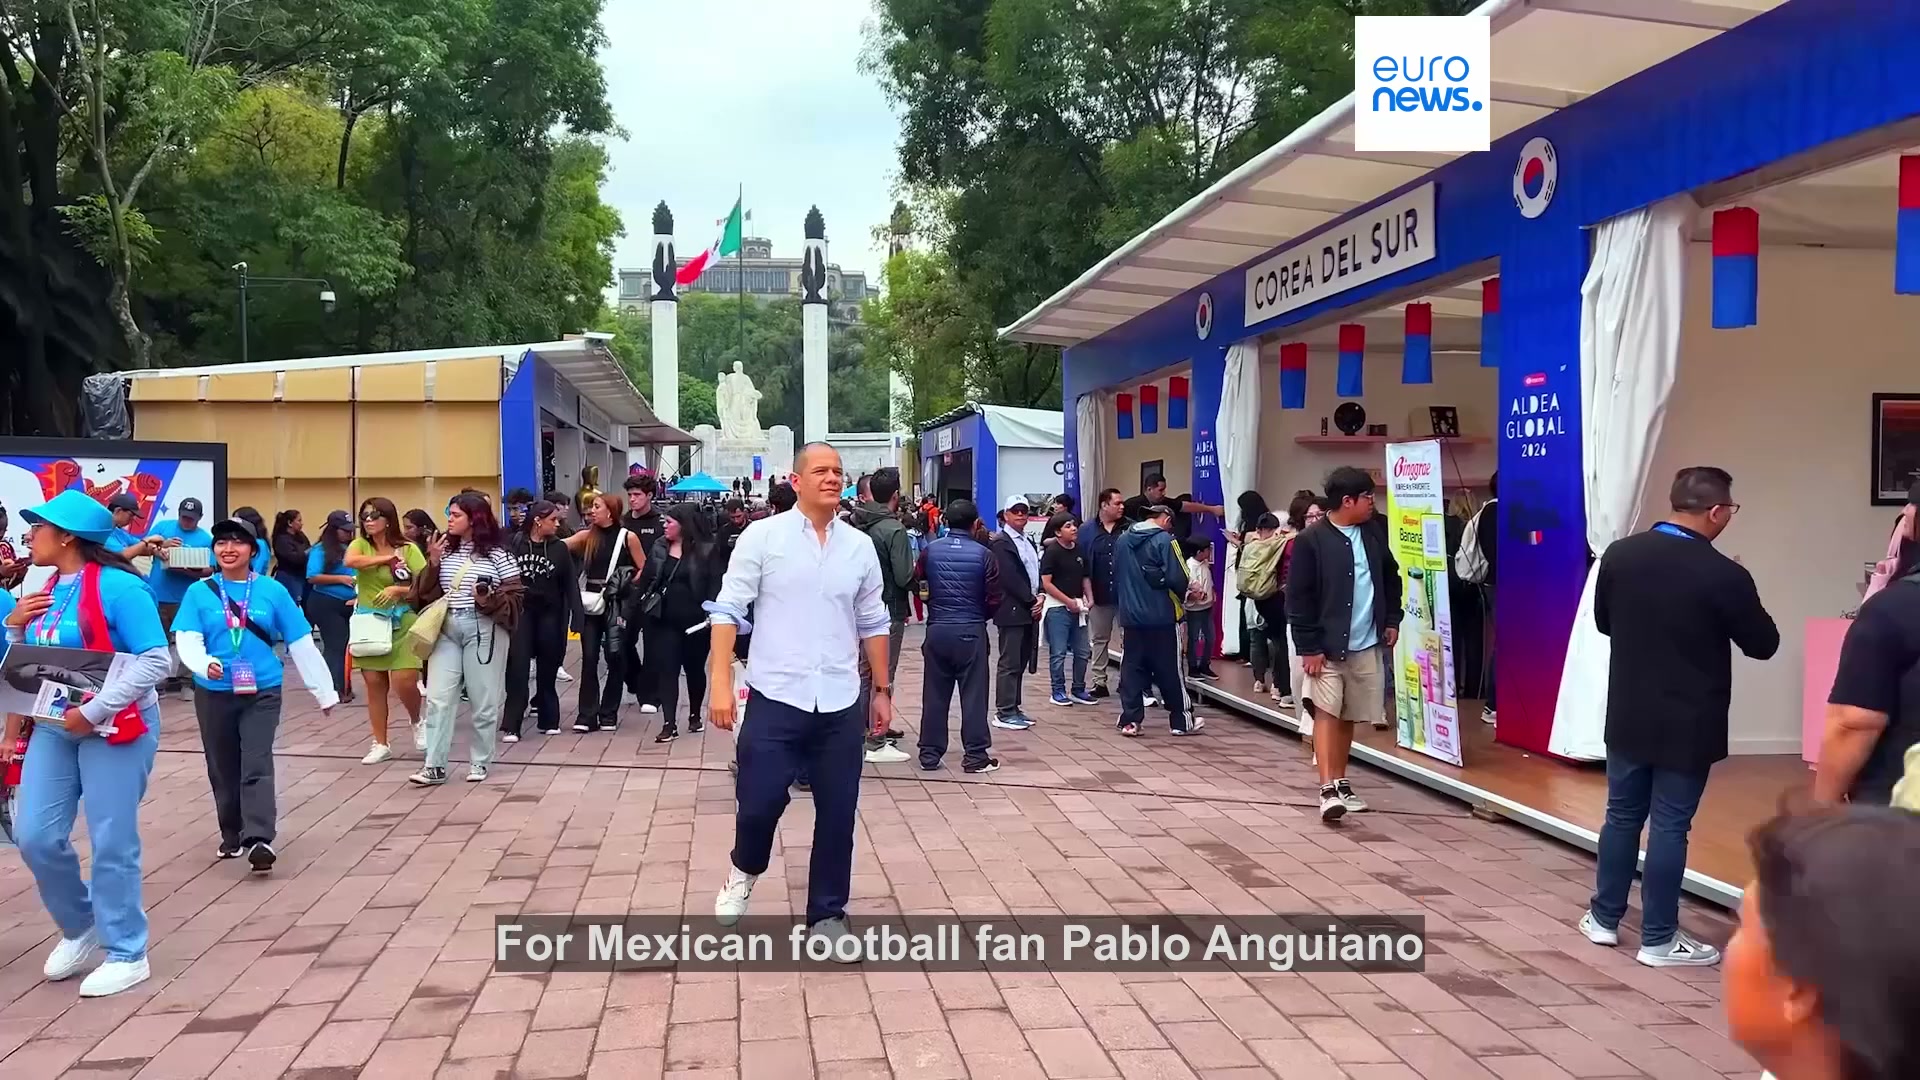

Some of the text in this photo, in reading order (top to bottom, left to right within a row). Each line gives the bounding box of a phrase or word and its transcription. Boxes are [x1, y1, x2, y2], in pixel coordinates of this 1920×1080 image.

[1254, 208, 1418, 310] COREA DEL SUR
[1511, 392, 1560, 416] ALDEA
[1506, 416, 1565, 439] GLOBAL
[1521, 443, 1547, 457] 2026
[1400, 528, 1422, 544] Banana
[517, 554, 556, 571] MERICAN
